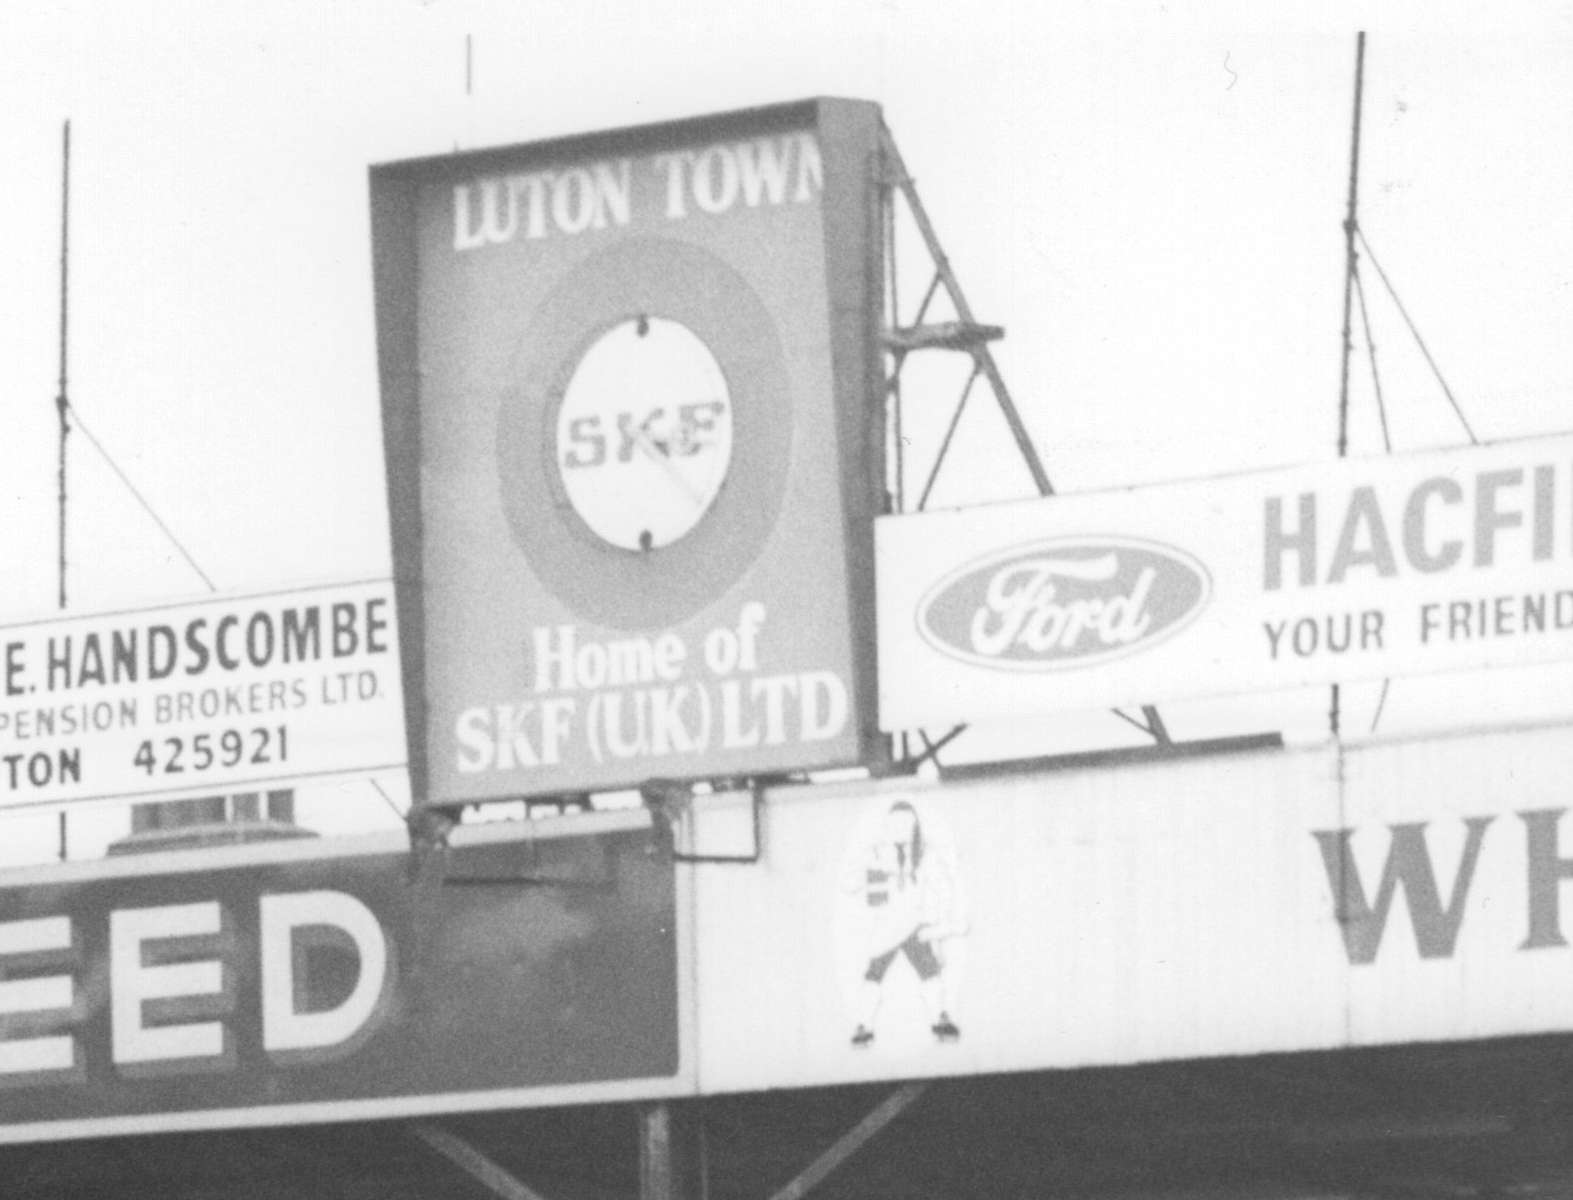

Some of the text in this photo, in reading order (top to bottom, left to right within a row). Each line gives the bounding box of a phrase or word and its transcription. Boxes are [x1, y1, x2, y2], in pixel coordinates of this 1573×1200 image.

[452, 130, 823, 252] LUTON TOWN
[564, 401, 725, 469] SKF
[1263, 463, 1573, 592] HACFI
[532, 602, 766, 691] Home of
[970, 550, 1157, 656] Ford
[1263, 588, 1573, 659] YOUR FRIEND
[155, 678, 307, 724] BROKERS
[454, 702, 576, 773] SKF
[720, 670, 848, 748] LTD
[133, 724, 289, 776] 425921
